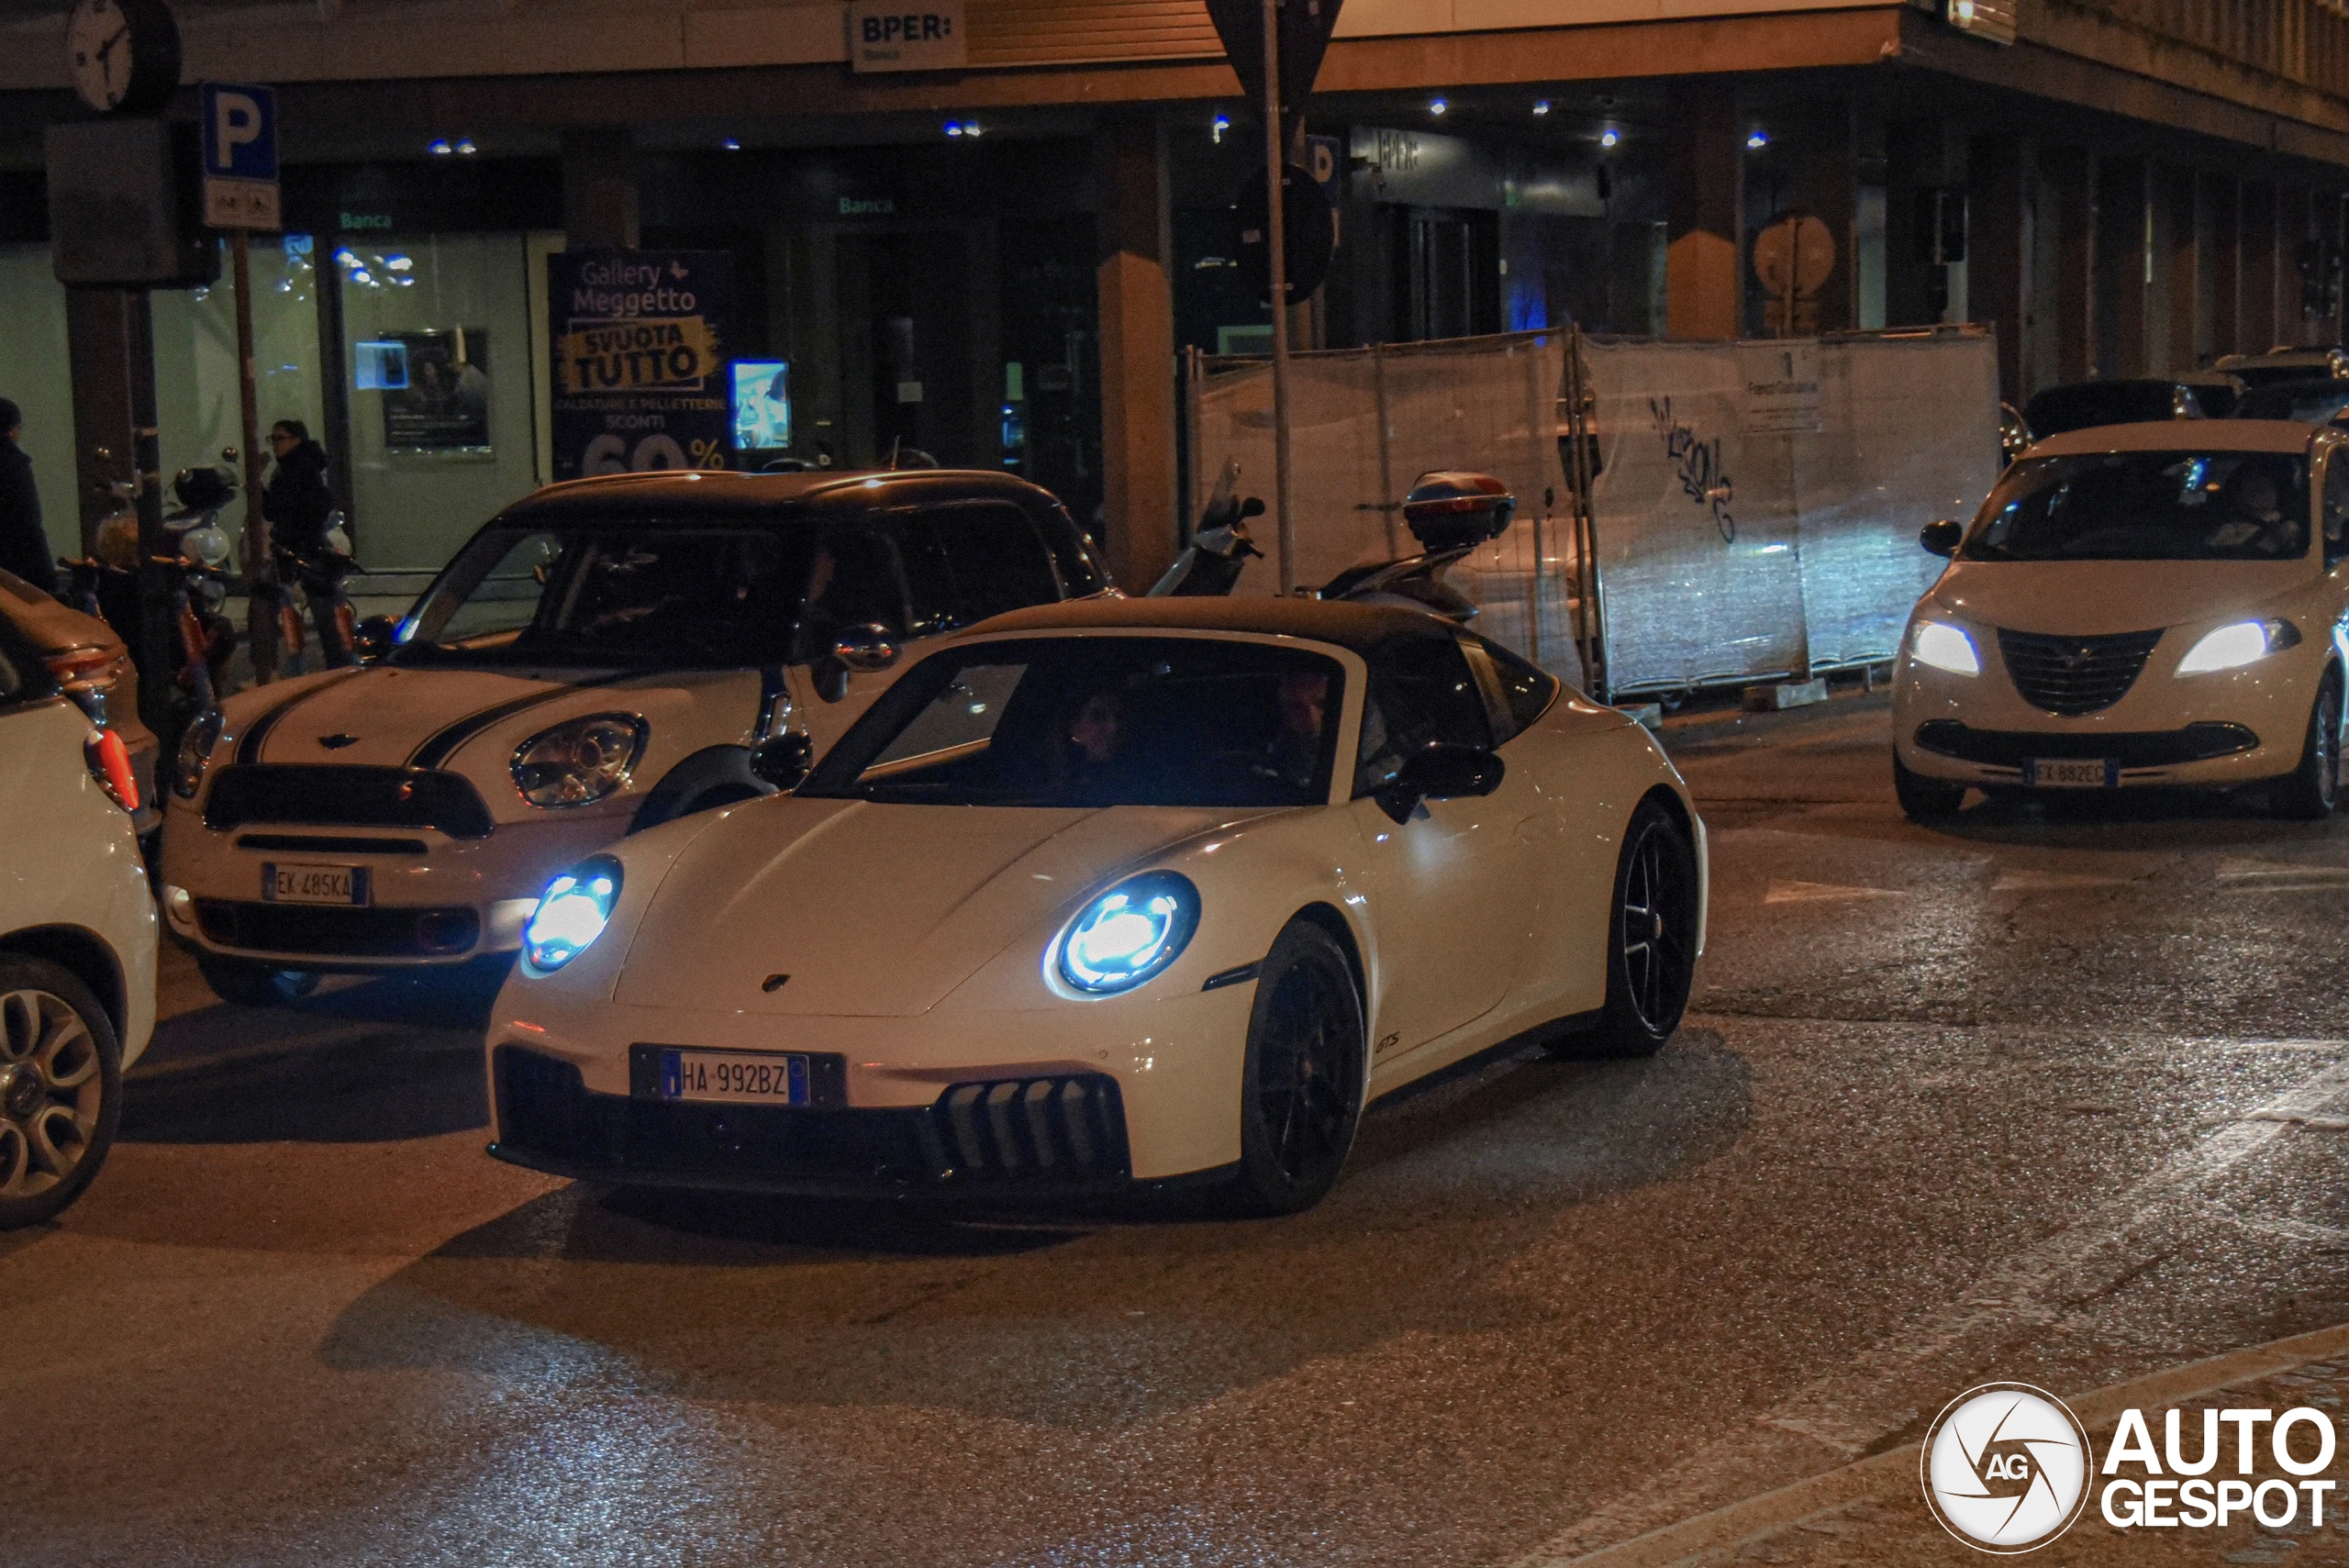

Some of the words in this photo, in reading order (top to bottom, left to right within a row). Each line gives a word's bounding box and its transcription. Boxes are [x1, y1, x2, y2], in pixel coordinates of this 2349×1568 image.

[863, 15, 951, 42] BPER:
[216, 93, 262, 169] P
[840, 197, 894, 214] Banca
[340, 212, 393, 228] Banca
[582, 261, 662, 290] Gallery
[573, 288, 696, 317] Meggetto
[585, 324, 685, 352] SVUOTA
[575, 345, 698, 389] TUTTO
[605, 415, 665, 429] SCONTI
[278, 872, 295, 895] EK
[302, 873, 351, 896] 485KA
[1376, 1031, 1400, 1053] GTS
[682, 1062, 707, 1092] HA
[717, 1062, 786, 1095] 992BZ
